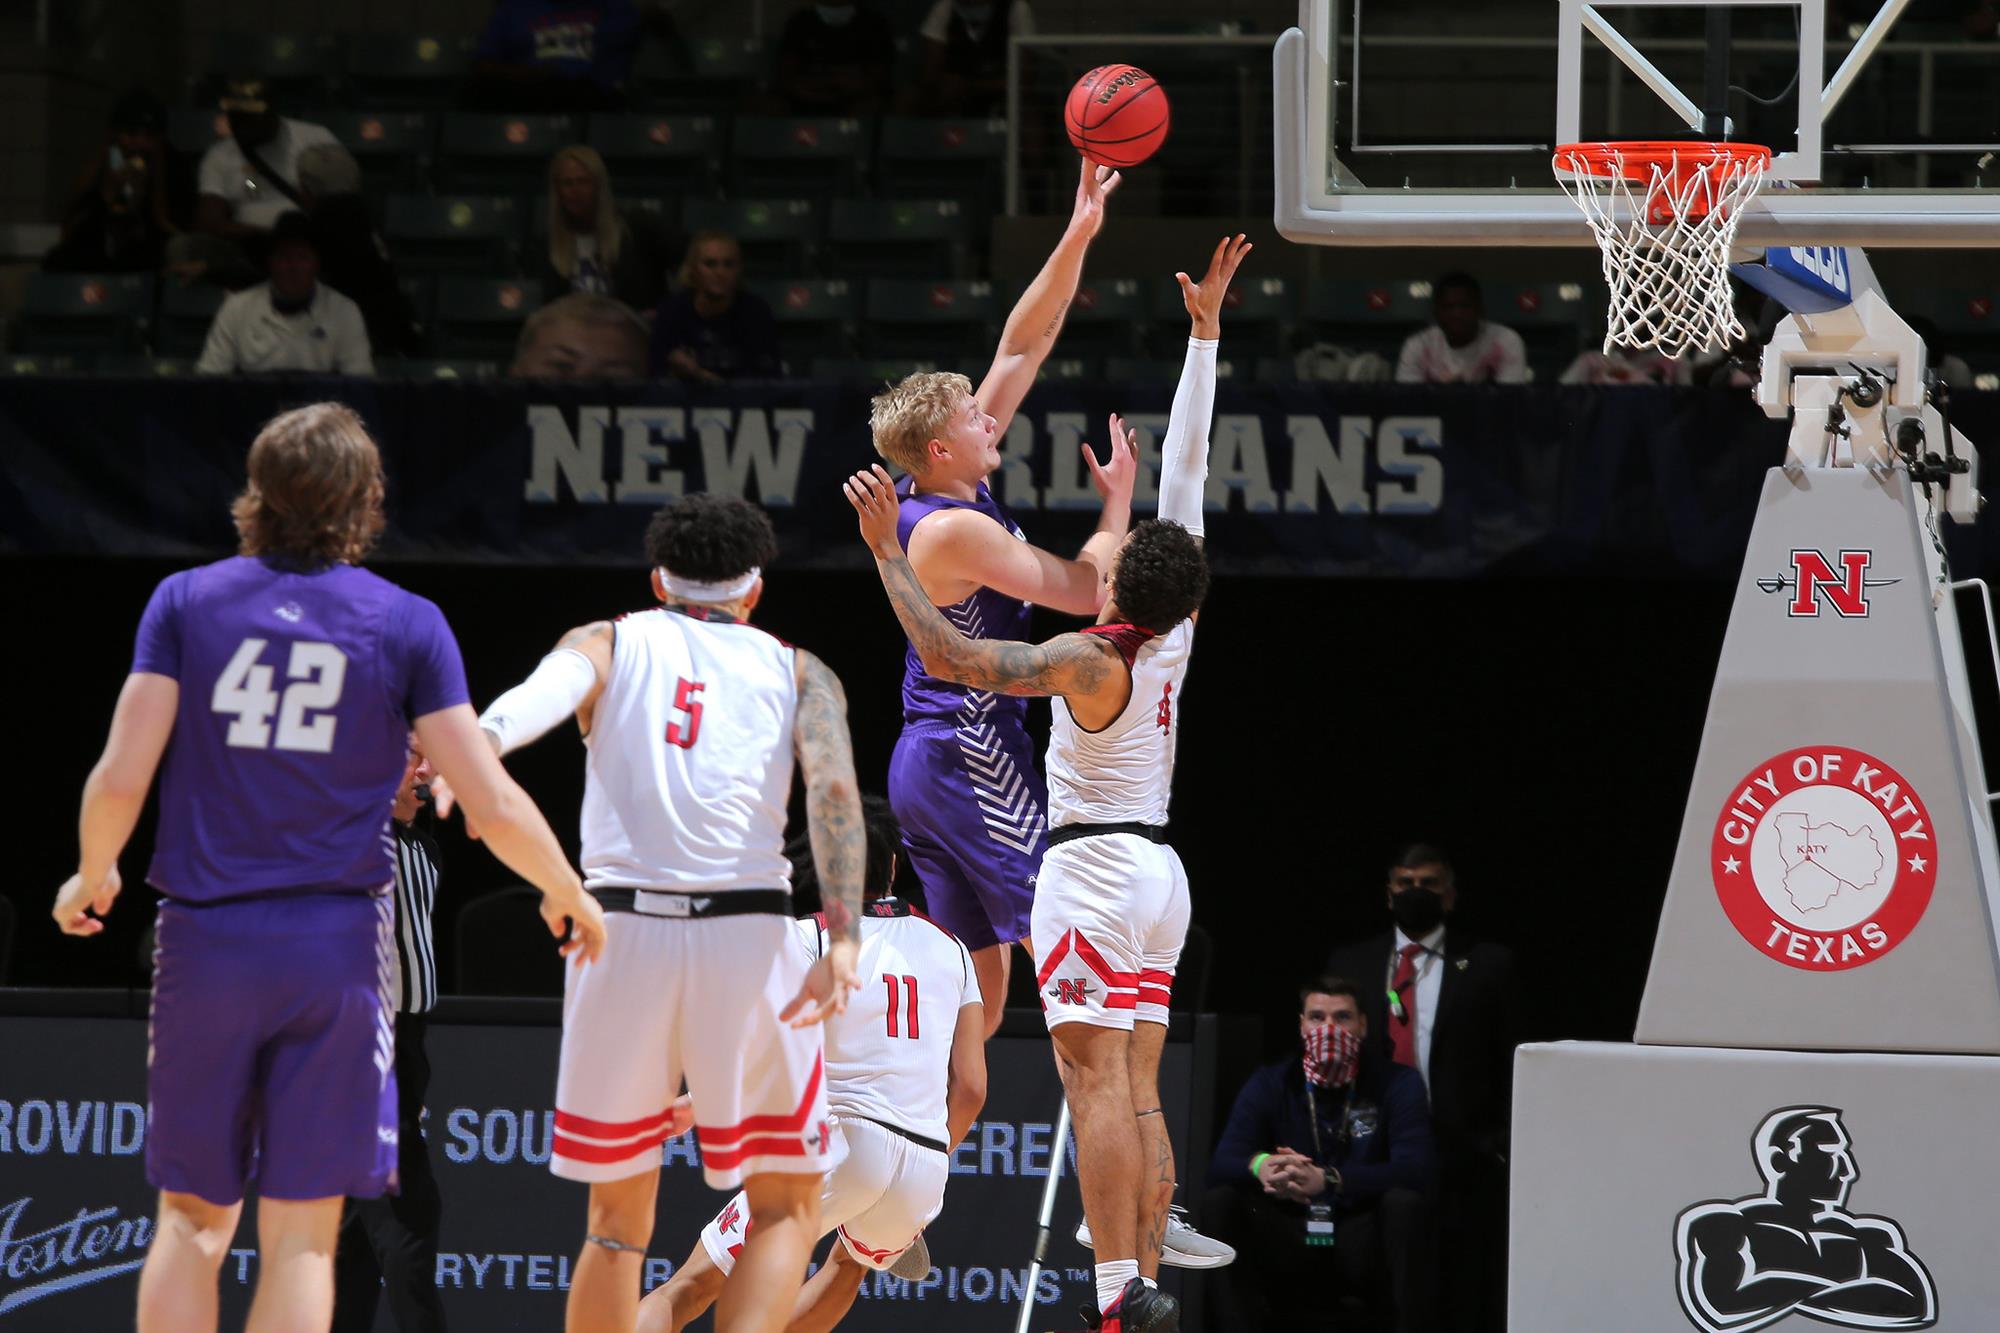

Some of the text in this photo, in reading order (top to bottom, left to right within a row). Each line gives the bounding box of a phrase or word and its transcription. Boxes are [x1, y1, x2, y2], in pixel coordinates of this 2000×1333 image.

[1096, 68, 1150, 105] Wilson
[524, 405, 814, 505] NEW
[1788, 549, 1872, 618] N
[211, 638, 347, 753] 42
[665, 676, 706, 750] 5
[1157, 680, 1172, 737] 4
[1723, 754, 1928, 845] CITY OF KATY
[1796, 844, 1829, 855] KATY
[1766, 920, 1888, 964] TEXAS
[882, 973, 920, 1040] 11
